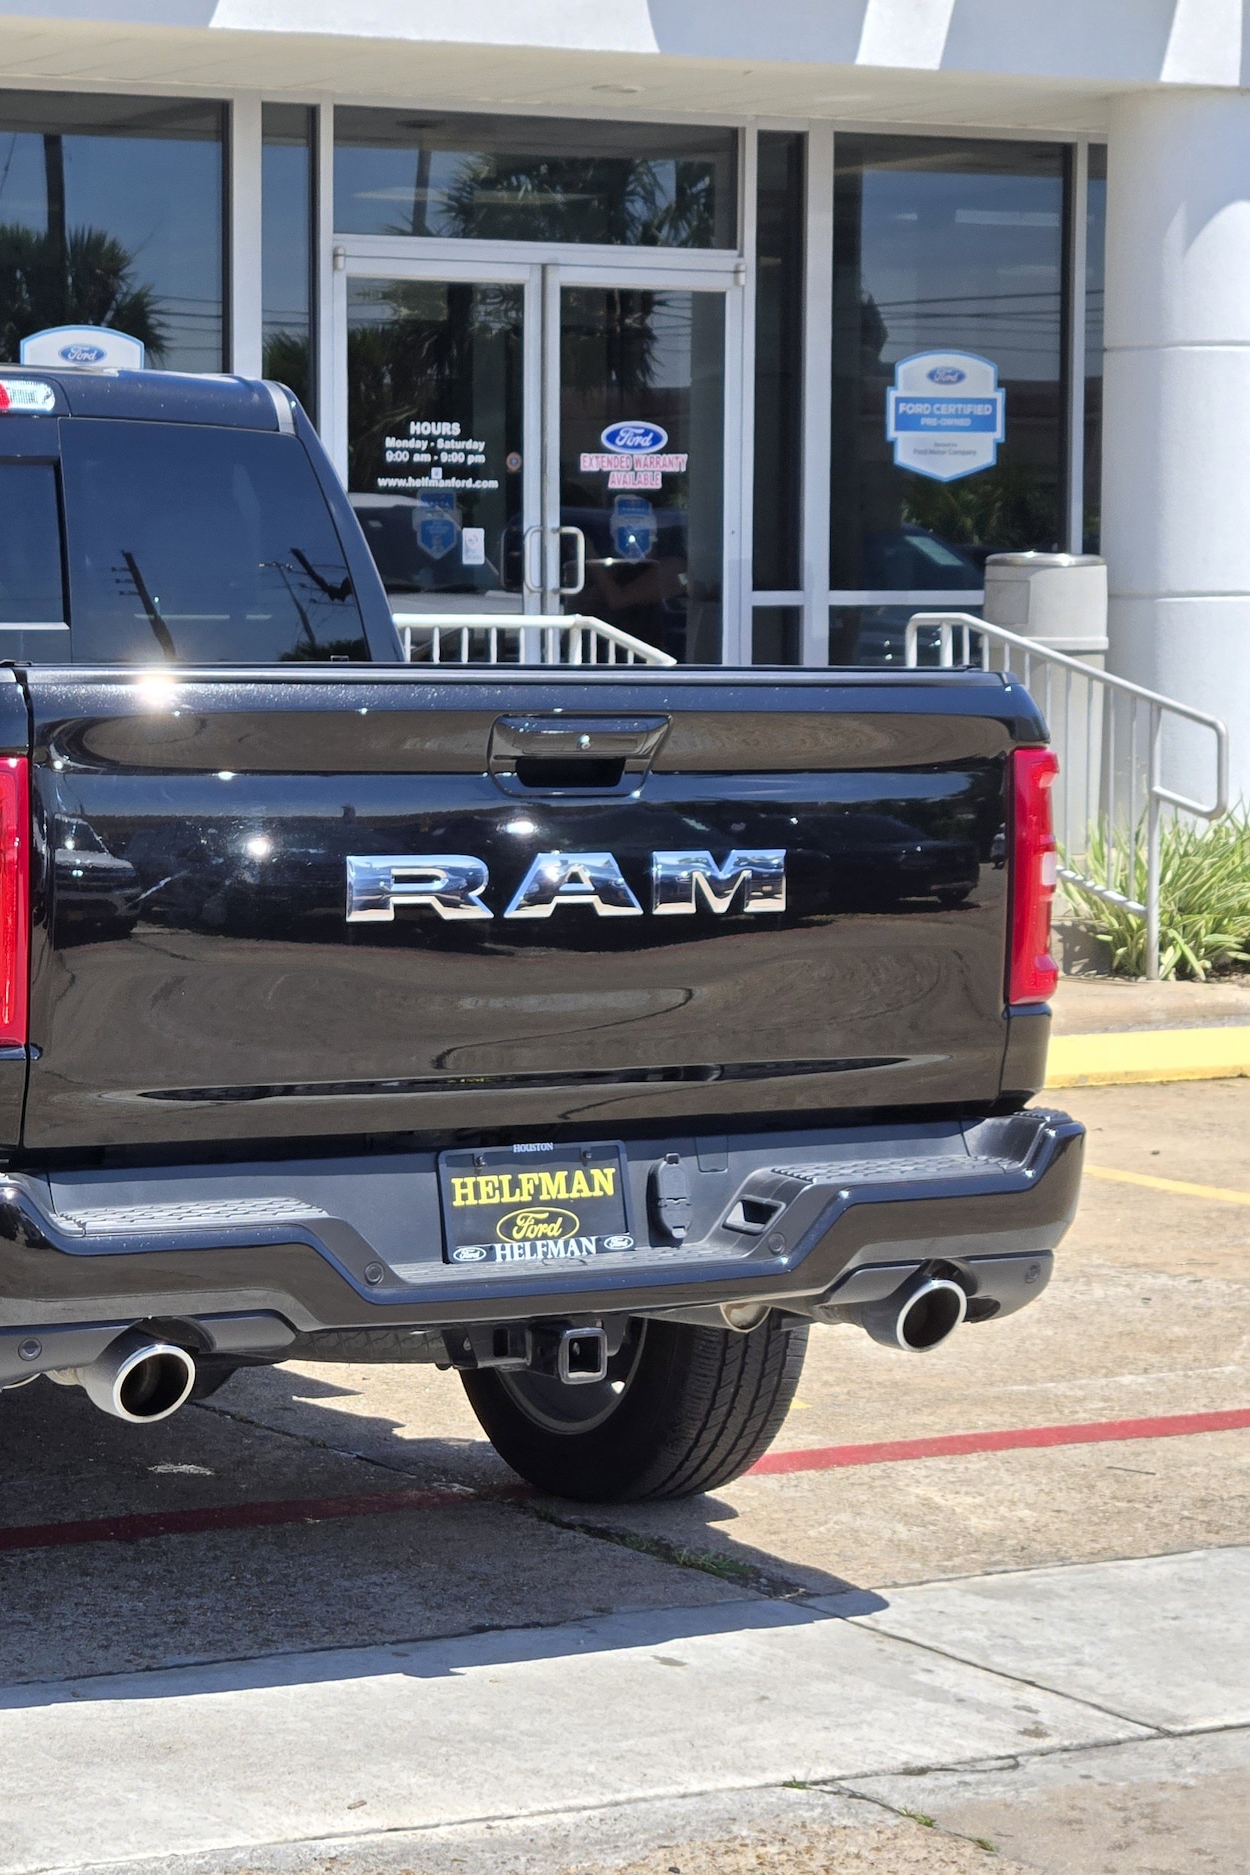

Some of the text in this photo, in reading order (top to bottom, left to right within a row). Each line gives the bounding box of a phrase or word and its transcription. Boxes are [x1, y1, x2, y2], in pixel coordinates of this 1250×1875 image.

[67, 346, 97, 361] Ford
[899, 403, 992, 415] FORD CERTIFIED
[410, 421, 461, 436] HOURS
[921, 418, 971, 426] PRE-OWNED
[385, 437, 428, 451] Monday
[437, 438, 485, 452] Saturday
[386, 451, 410, 463] 9:00
[413, 453, 431, 463] am
[440, 452, 464, 464] 9:00
[467, 453, 485, 466] pm
[581, 454, 687, 471] EXTENDED WARRANTY
[378, 476, 499, 489] www.helfmanford.com
[609, 472, 661, 487] AVAILABLE
[346, 849, 787, 922] RAM
[513, 1143, 554, 1153] HOUSTON
[451, 1168, 616, 1207] HELFMAN
[511, 1212, 563, 1240] Ford
[494, 1237, 599, 1263] HELFMAN
